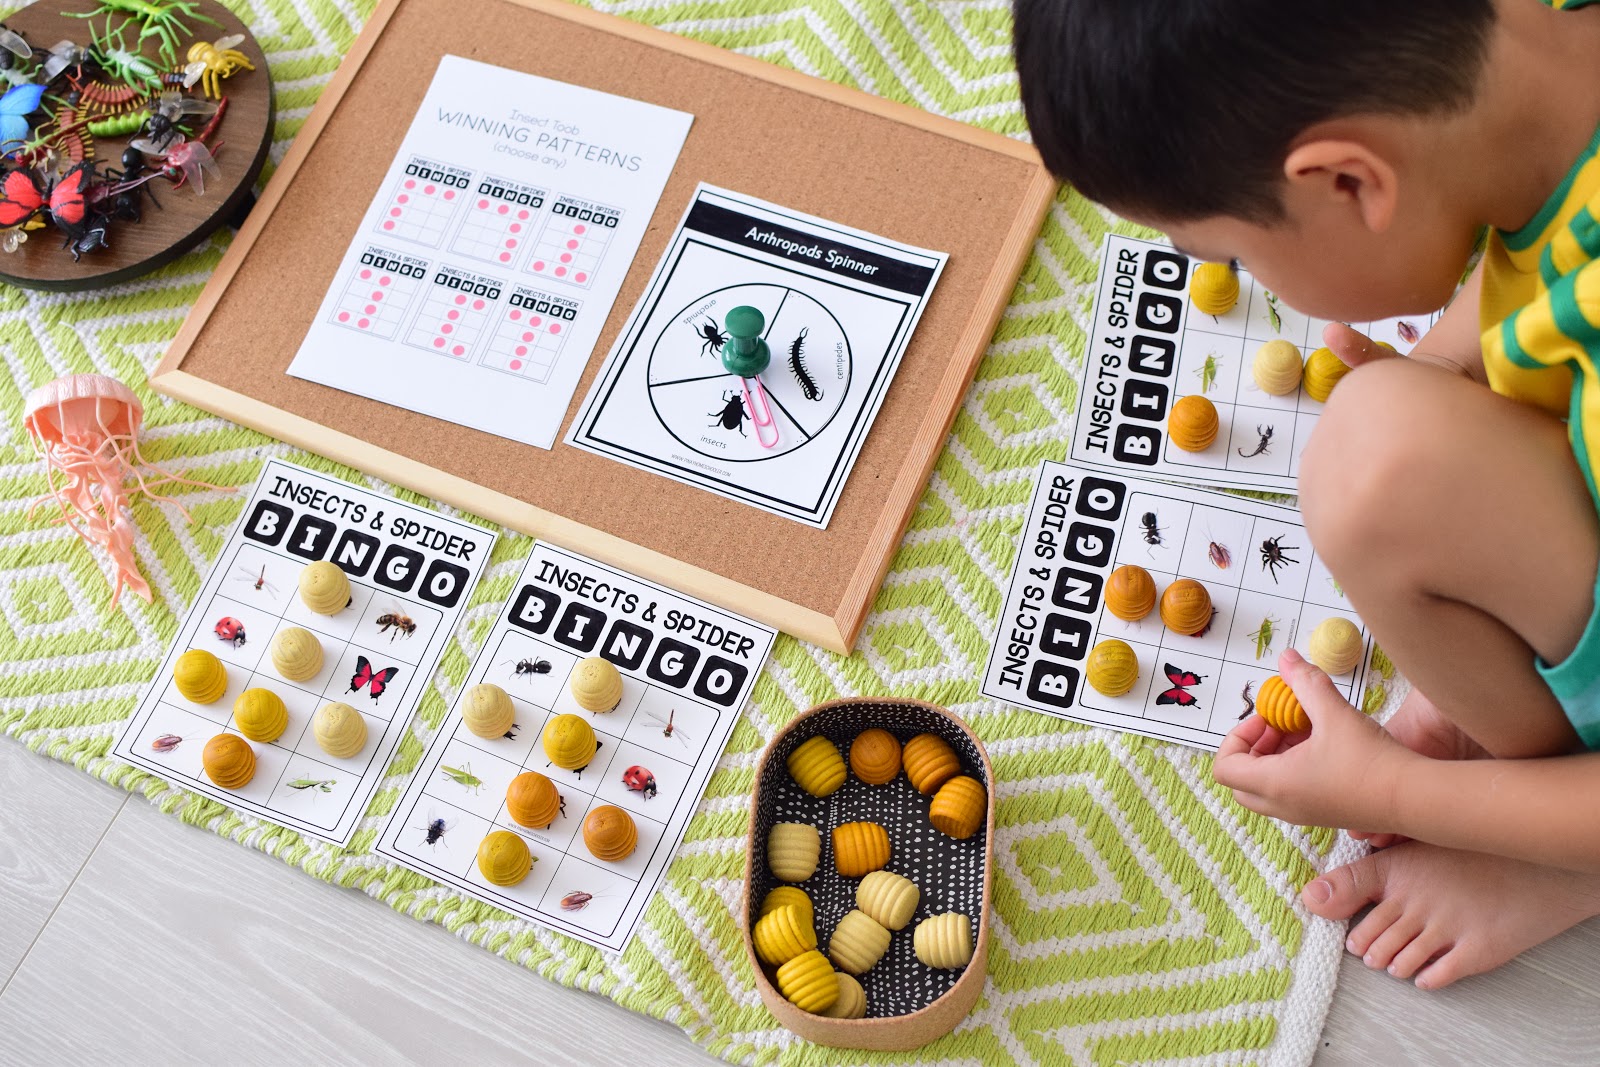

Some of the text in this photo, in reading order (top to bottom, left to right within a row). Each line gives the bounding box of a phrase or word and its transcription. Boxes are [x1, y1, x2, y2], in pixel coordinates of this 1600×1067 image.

[509, 109, 580, 136] Insect Toob
[437, 107, 643, 173] WINNING PATTERNS
[411, 157, 441, 170] INSECTS
[447, 167, 473, 178] SPIDER
[493, 141, 568, 170] (choose any)
[407, 164, 468, 188] BINGO
[485, 176, 515, 190] INSECTS
[521, 185, 546, 197] SPIDER
[480, 184, 543, 207] BINGO
[558, 195, 588, 209] INSECTS
[595, 205, 621, 217] SPIDER
[554, 203, 618, 227] BINGO
[367, 246, 397, 260] INSECTS
[403, 256, 429, 268] SPIDER
[744, 226, 879, 276] Arthropods Spinner
[362, 254, 424, 278] BINGO
[441, 266, 471, 280] INSECTS
[477, 275, 503, 288] SPIDER
[436, 274, 499, 298] BINGO
[516, 286, 546, 300] INSECTS
[553, 296, 579, 309] SPIDER
[511, 295, 575, 319] BINGO
[683, 299, 717, 325] arachnids
[834, 341, 846, 380] centipedes
[1086, 248, 1139, 454] INSECTS & SPIDER
[1123, 259, 1181, 457] BINGO
[700, 434, 727, 449] insects
[268, 476, 477, 561] INSECTS & SPIDER
[253, 508, 457, 598] BINGO
[999, 475, 1075, 690] INSECTS & SPIDER
[1037, 487, 1116, 698] BINGO
[534, 559, 755, 659] INSECTS & SPIDER
[518, 594, 734, 695] BINGO
